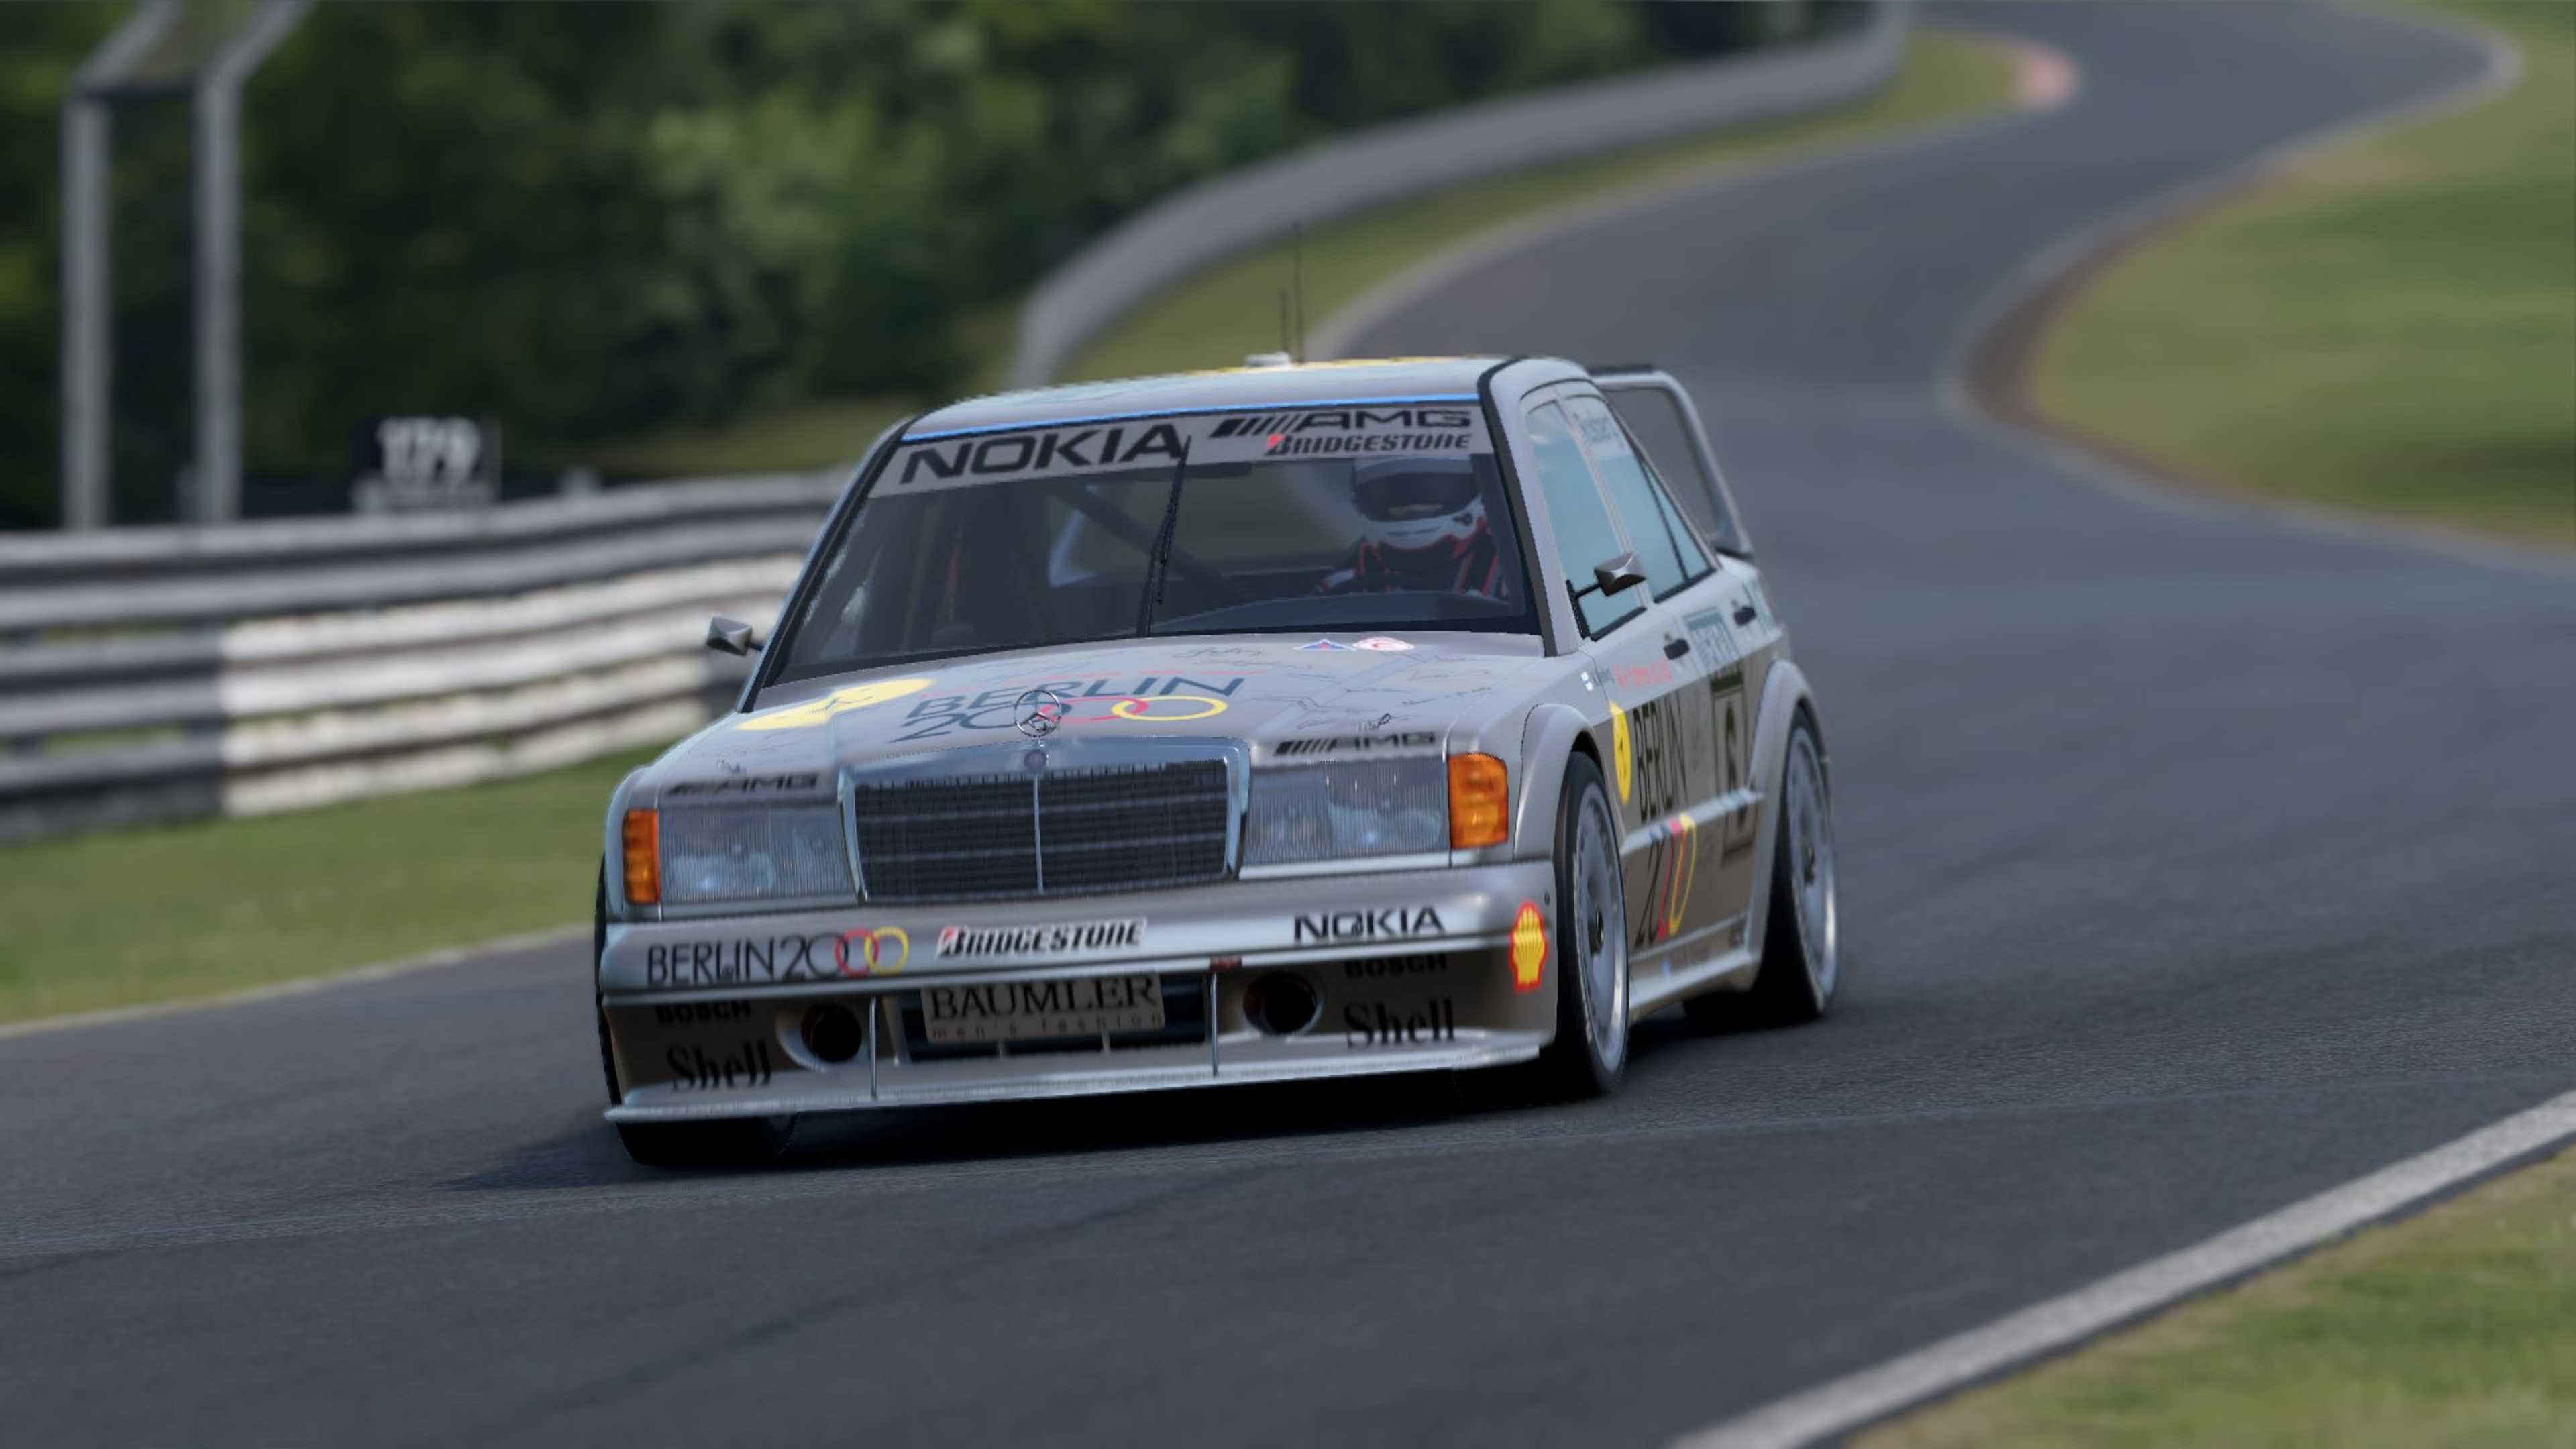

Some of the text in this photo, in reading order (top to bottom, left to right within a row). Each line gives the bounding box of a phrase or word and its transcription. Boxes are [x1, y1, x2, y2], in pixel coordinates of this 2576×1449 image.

[1295, 410, 1472, 433] AMG
[899, 423, 1185, 485] NOKIA
[1264, 433, 1472, 457] BRIDGESTONE
[889, 695, 1228, 743] 2000
[906, 676, 1245, 719] BERLIN
[1632, 691, 1688, 822] BERLIN
[939, 920, 1144, 958] BRIDGESTONE
[1293, 906, 1446, 944] NOKIA
[1343, 996, 1455, 1049] Shell
[667, 1040, 772, 1092] Shell
